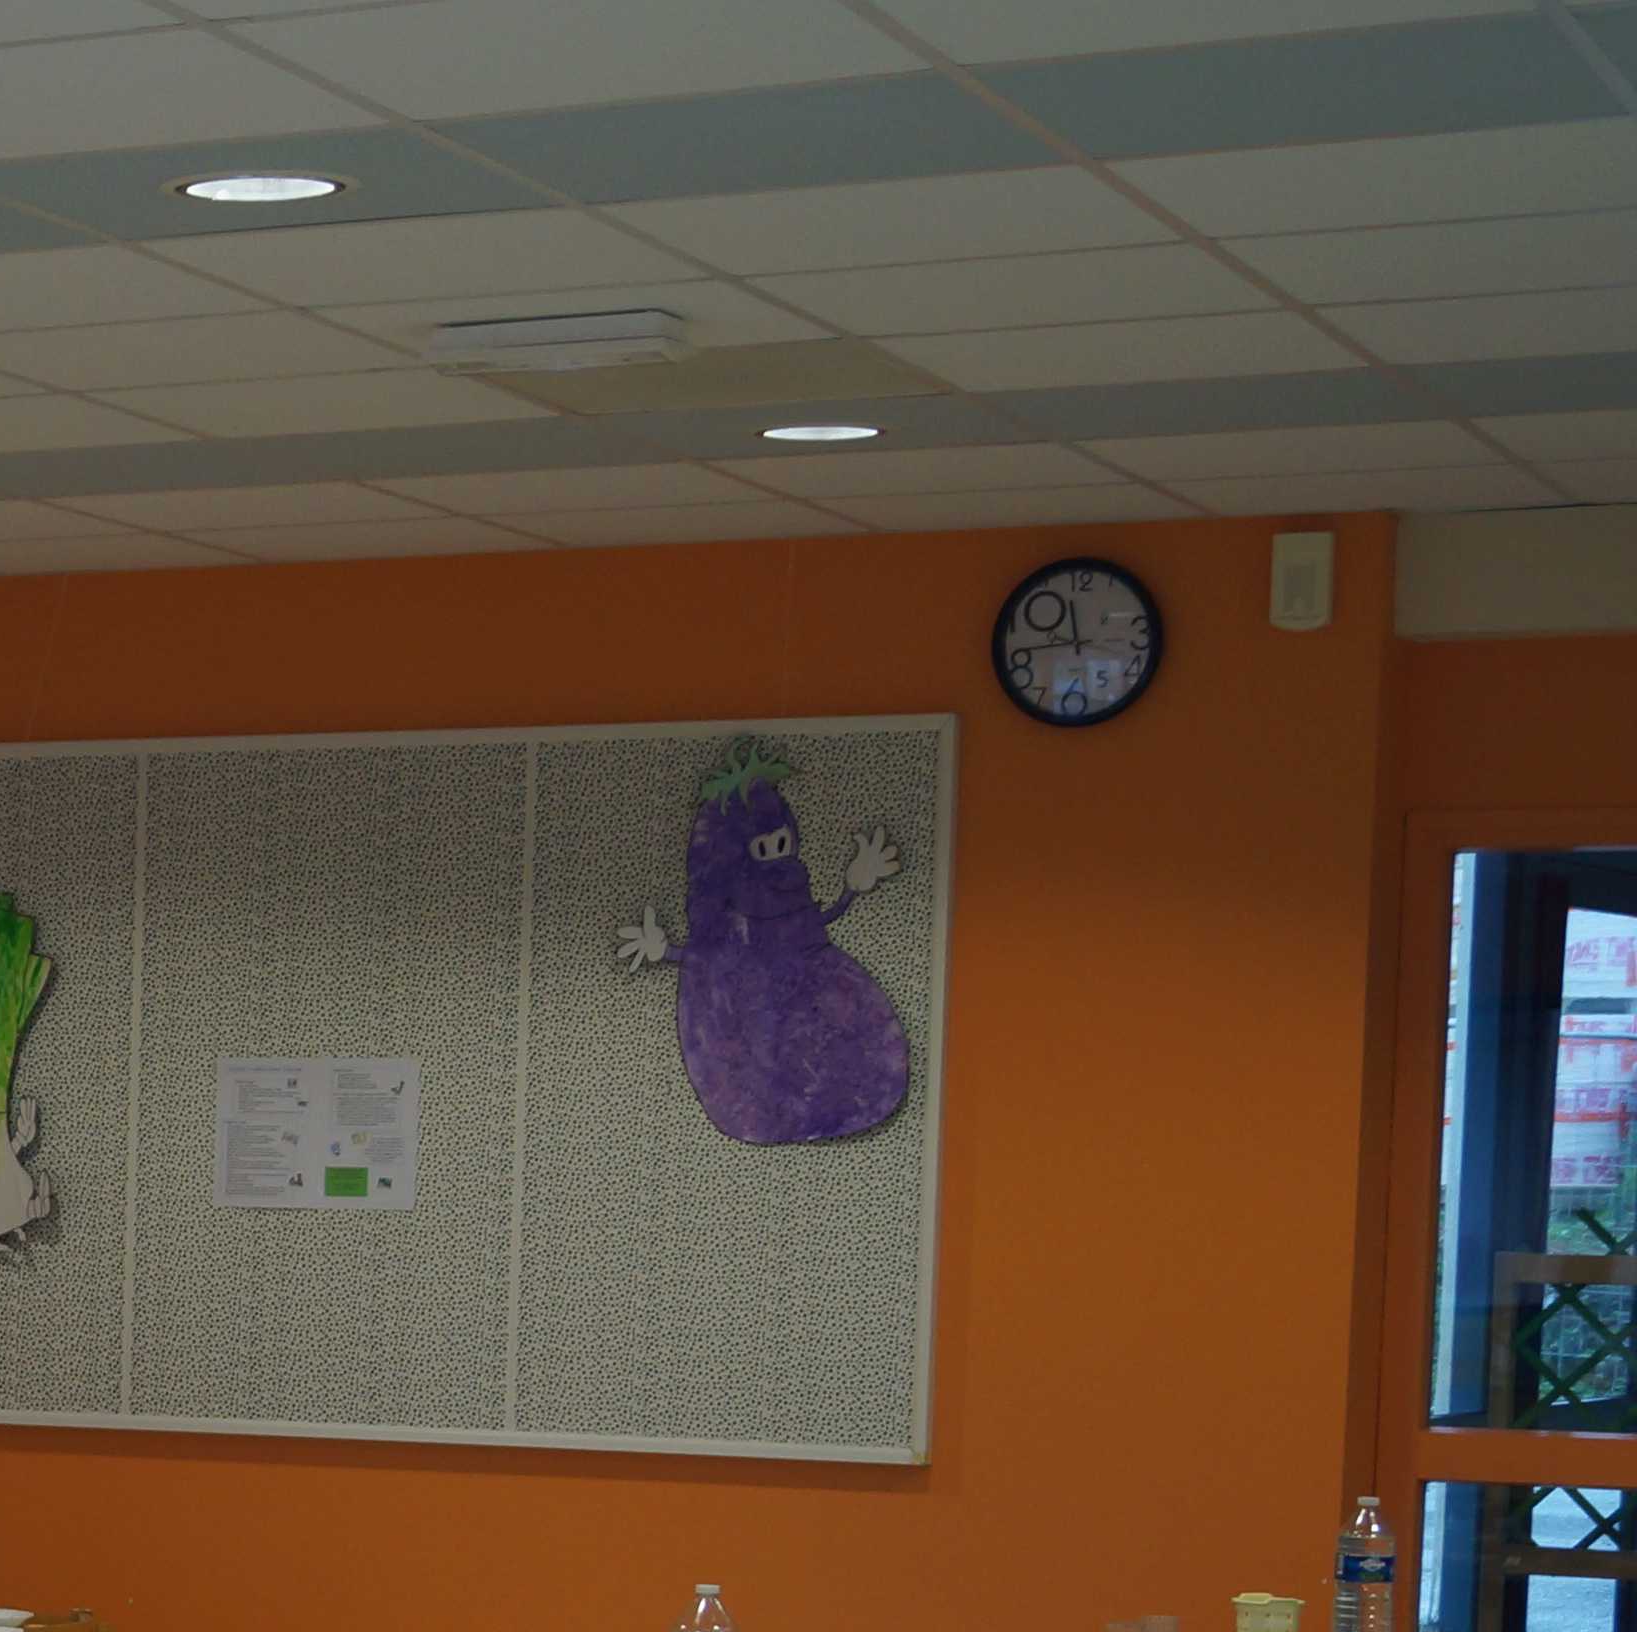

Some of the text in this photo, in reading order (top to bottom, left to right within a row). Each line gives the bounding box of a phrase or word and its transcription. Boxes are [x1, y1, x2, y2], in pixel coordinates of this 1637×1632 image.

[1069, 571, 1093, 593] 12
[1130, 614, 1150, 650] 3
[1011, 648, 1034, 689] 8
[1124, 653, 1142, 678] 4
[1096, 670, 1110, 688] 5
[1032, 687, 1046, 705] 7
[1061, 677, 1087, 715] 6
